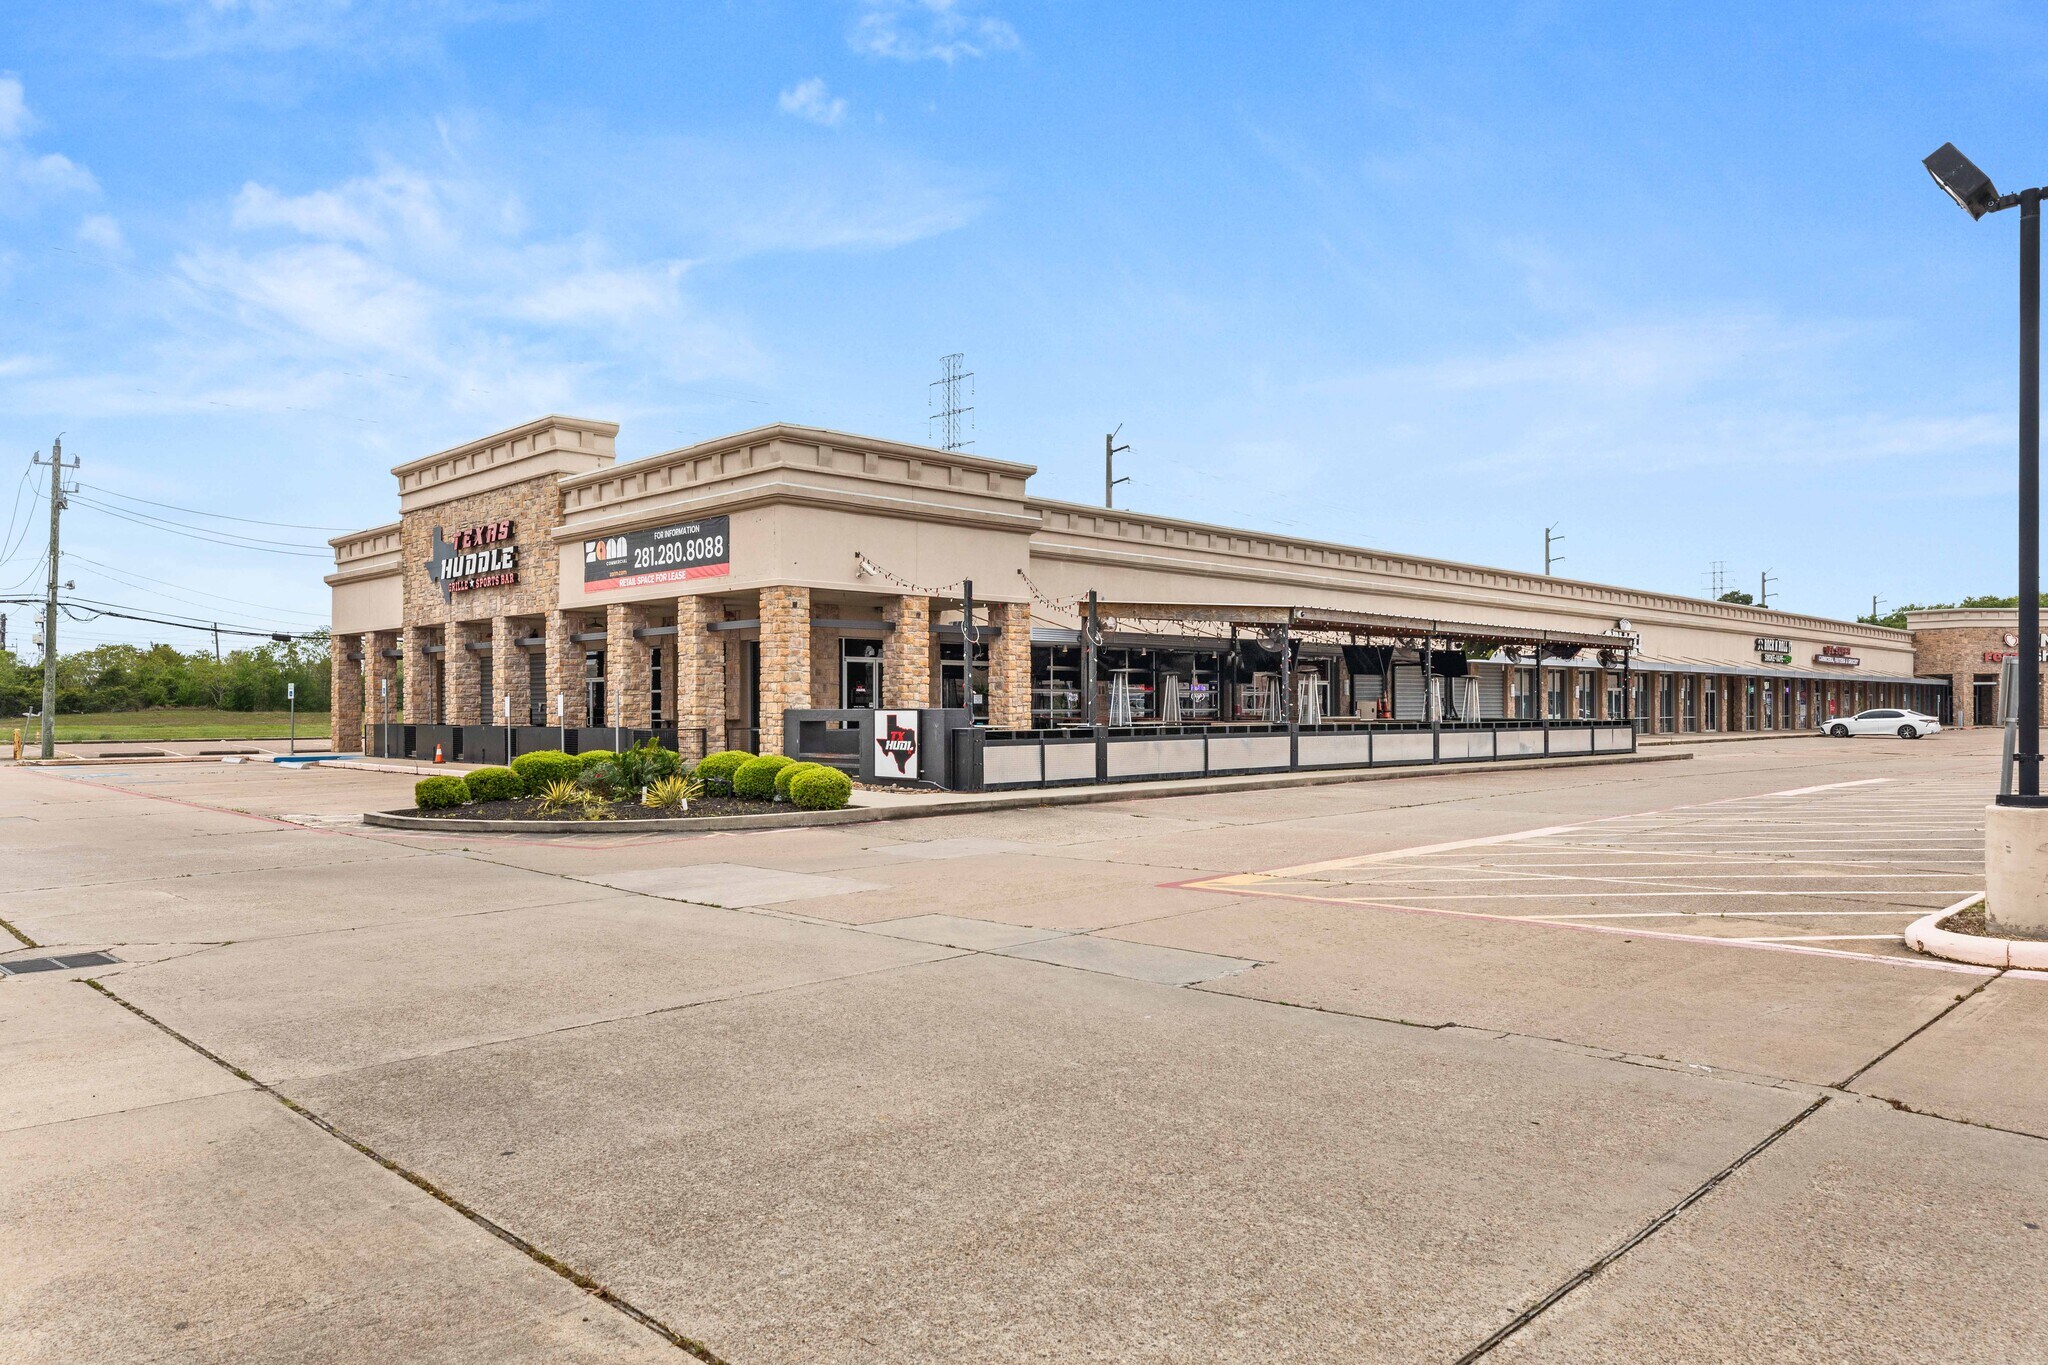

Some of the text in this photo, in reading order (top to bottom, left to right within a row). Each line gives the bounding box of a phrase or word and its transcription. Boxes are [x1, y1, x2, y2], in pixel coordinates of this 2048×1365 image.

[452, 520, 513, 550] TEXAS
[654, 525, 700, 540] FOR INFORMATION
[634, 535, 724, 569] 281.280.8088
[441, 546, 515, 580] HUDDLE
[448, 573, 515, 592] GRILLE SPORTS BAR
[619, 570, 687, 587] RETAIL SPACE FOR LEASE
[890, 731, 906, 741] TX
[885, 740, 914, 751] HUDL
